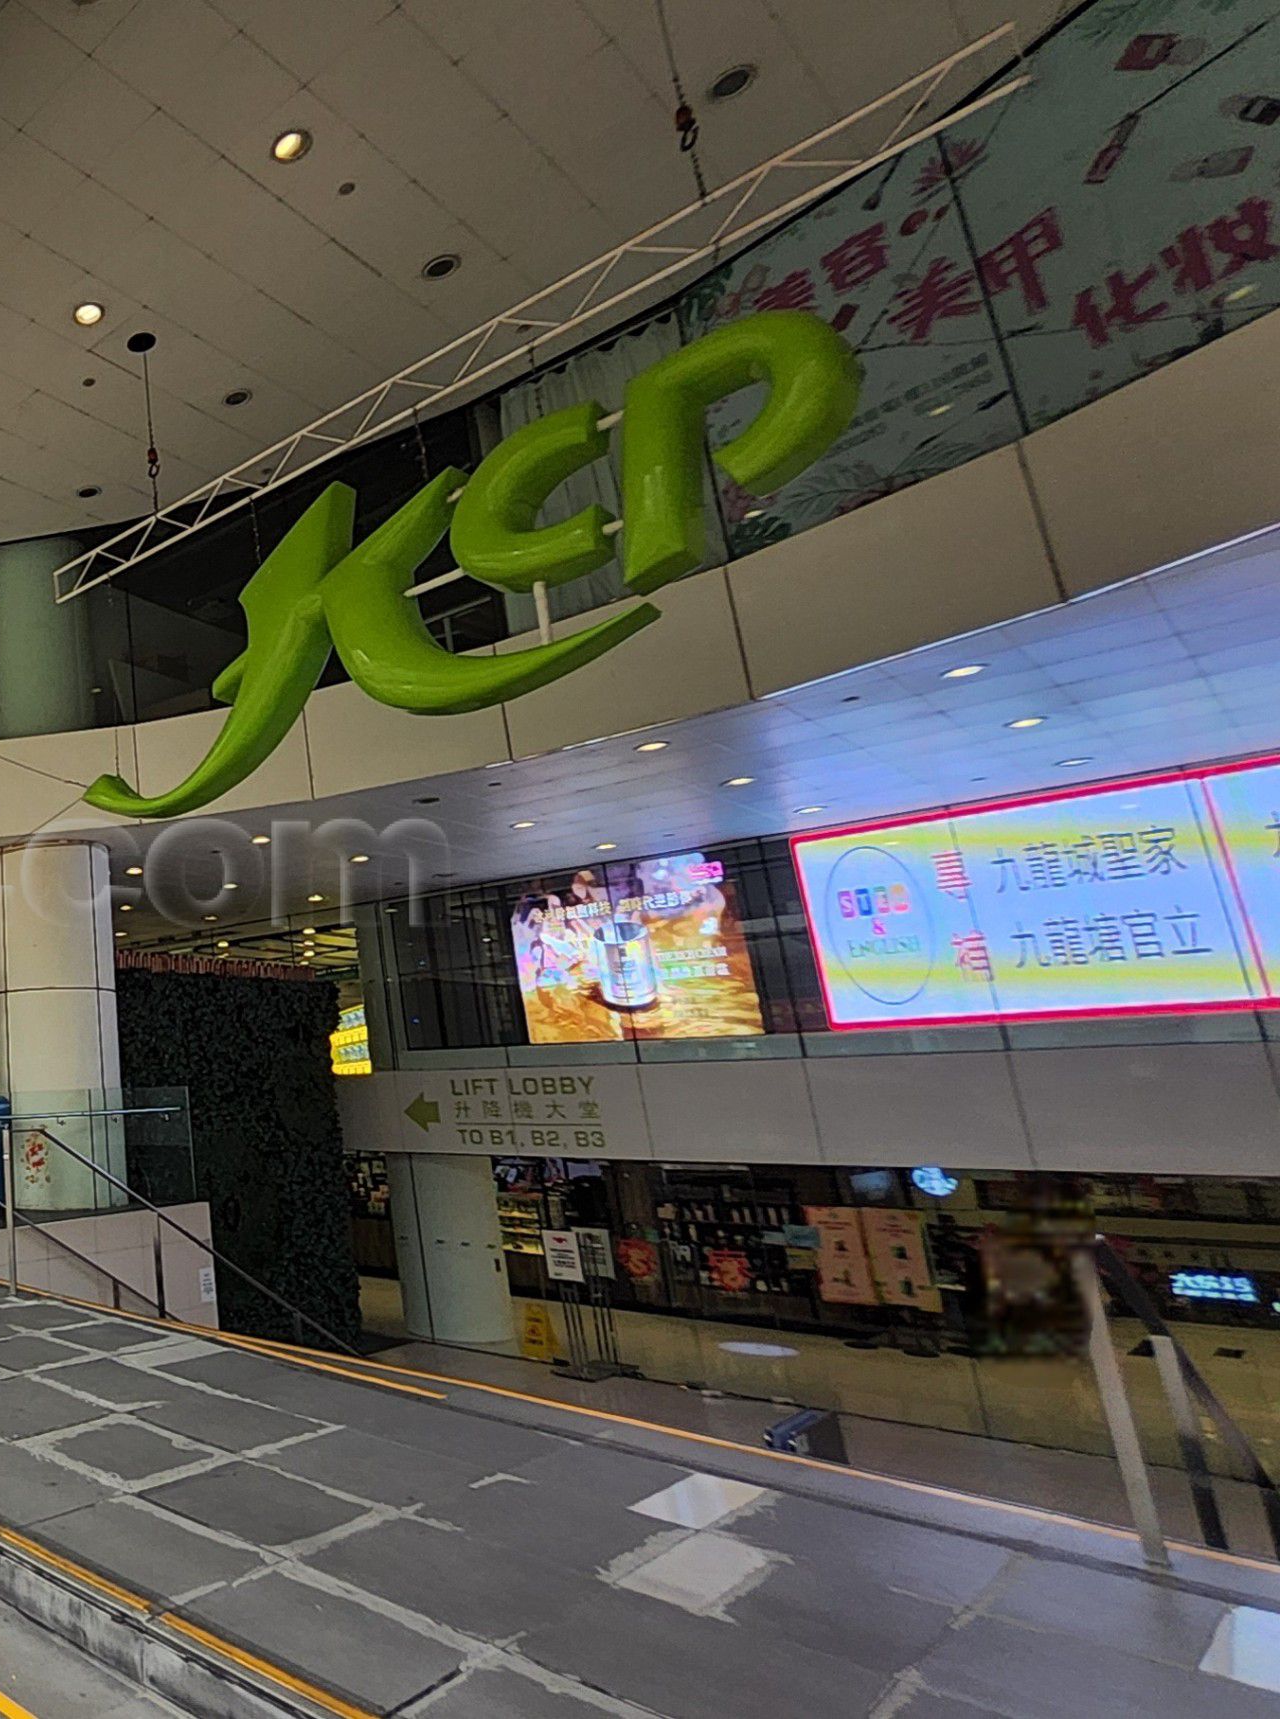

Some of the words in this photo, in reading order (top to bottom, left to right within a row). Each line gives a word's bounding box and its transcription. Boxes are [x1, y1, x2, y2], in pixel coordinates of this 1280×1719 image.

[83, 309, 862, 818] KCP
[990, 825, 1187, 893] 九龍城聖家
[1010, 904, 1213, 968] 九龍塘官立
[449, 1078, 499, 1096] LIFT
[507, 1075, 595, 1096] LOBBY
[453, 1100, 601, 1119] 升降機大堂
[456, 1129, 484, 1146] TO
[574, 1131, 606, 1148] B3
